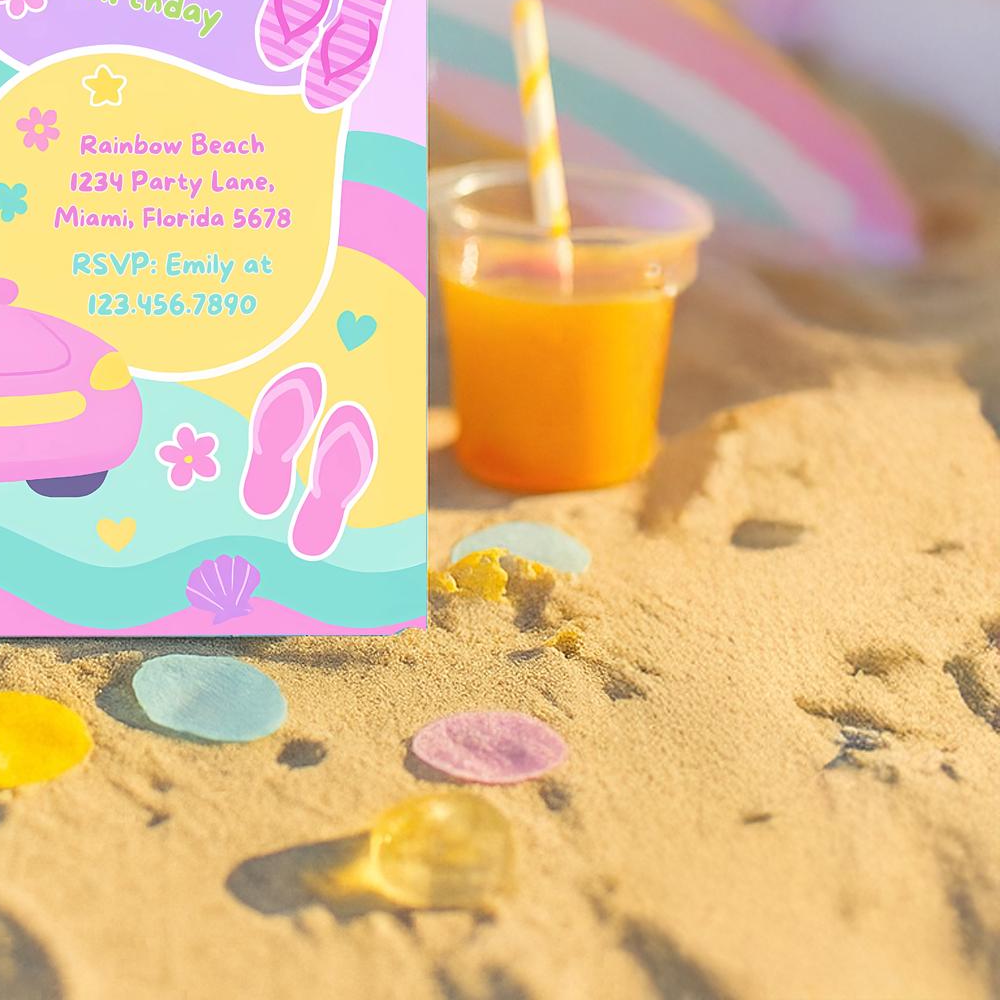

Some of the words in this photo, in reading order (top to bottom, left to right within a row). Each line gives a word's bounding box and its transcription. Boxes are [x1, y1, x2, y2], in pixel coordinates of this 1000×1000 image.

[79, 133, 183, 155] Rainbow
[190, 132, 266, 156] Beach
[69, 171, 124, 193] 1234
[130, 169, 203, 199] Party
[211, 169, 276, 193] Lane,
[53, 205, 135, 230] Miami,
[142, 206, 225, 229] Florida
[232, 207, 292, 229] 5678
[72, 251, 158, 276] RSVP:
[165, 252, 235, 284] Emily
[243, 254, 274, 275] at
[87, 292, 258, 317] 123.456.7890
